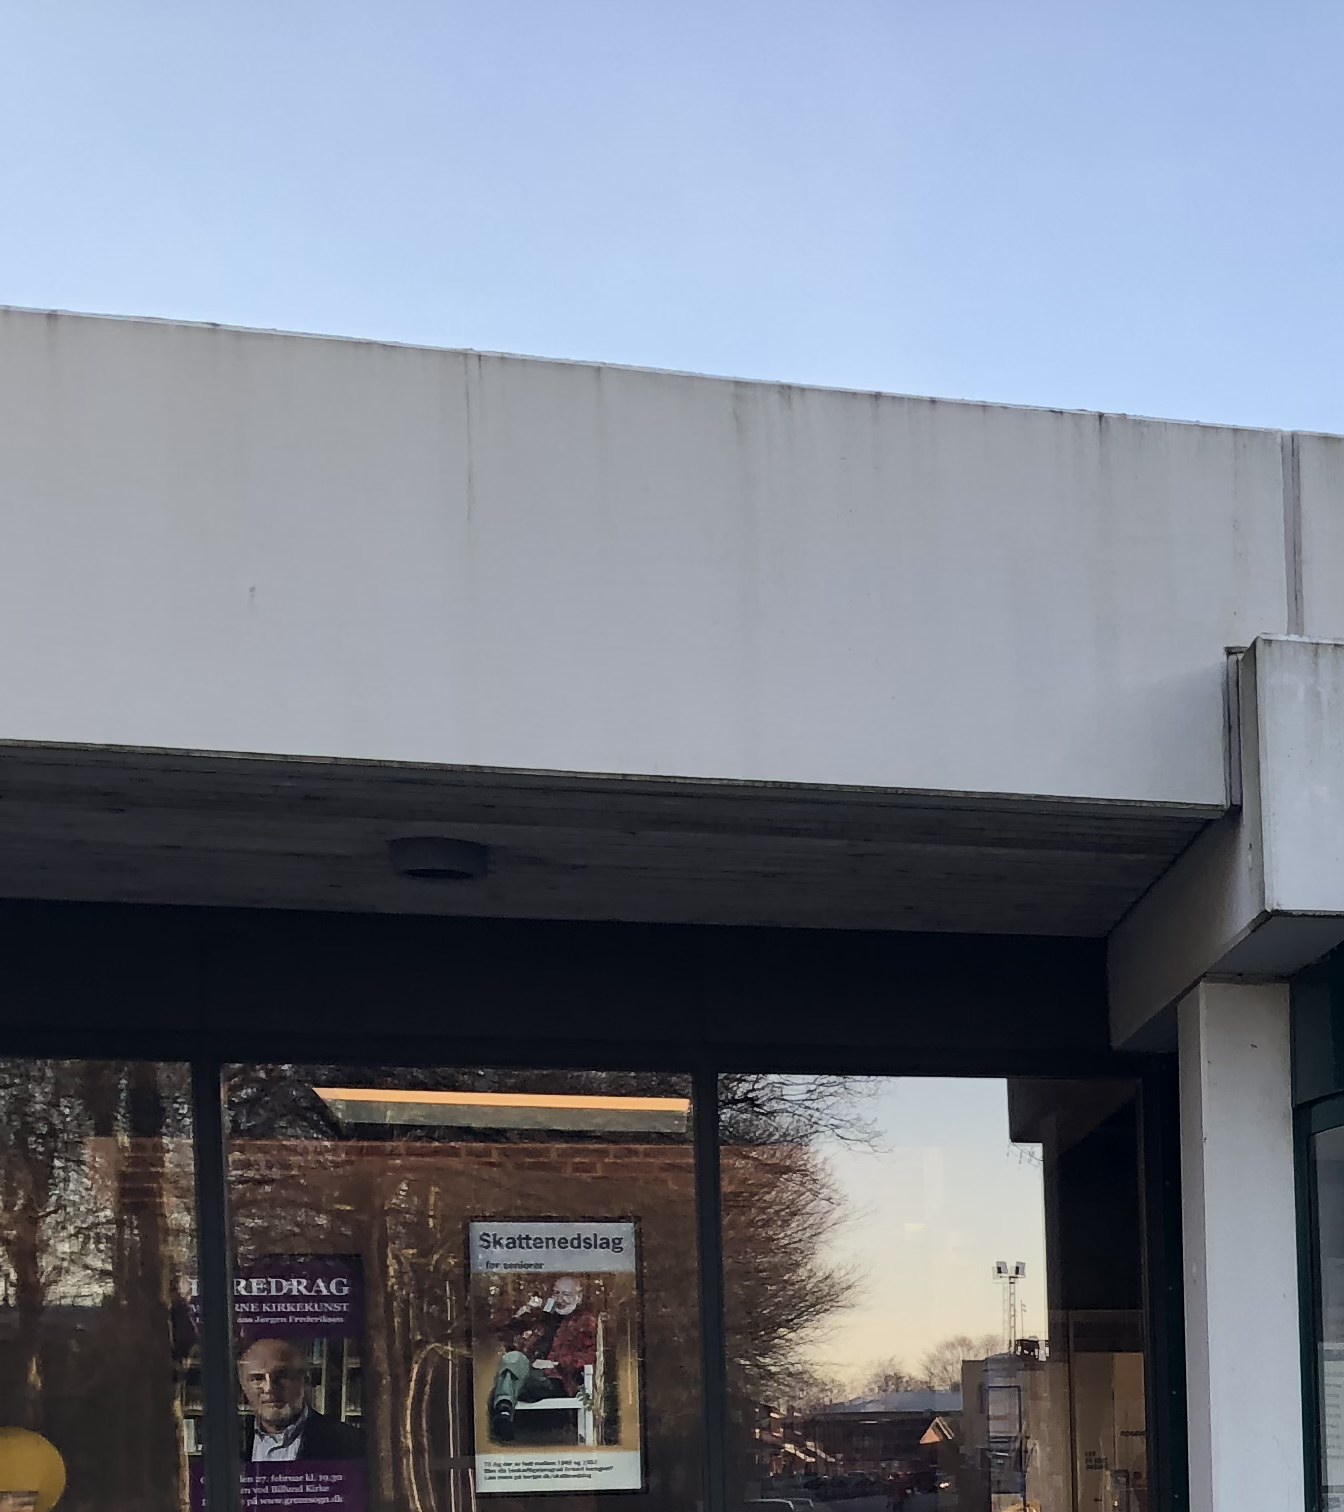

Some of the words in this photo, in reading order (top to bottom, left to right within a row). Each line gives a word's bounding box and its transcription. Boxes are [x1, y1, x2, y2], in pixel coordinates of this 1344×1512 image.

[479, 1232, 624, 1254] Skattenedslag
[503, 1260, 545, 1270] seniorer
[189, 1278, 350, 1296] REDRAG
[262, 1302, 350, 1312] KIRKEKUNST
[288, 1315, 344, 1323] Frederiksen
[270, 1474, 304, 1483] februar
[305, 1473, 317, 1482] kl.
[318, 1474, 343, 1483] 19.30
[271, 1485, 304, 1494] Billund
[305, 1484, 330, 1493] Kirke
[246, 1496, 258, 1506] på
